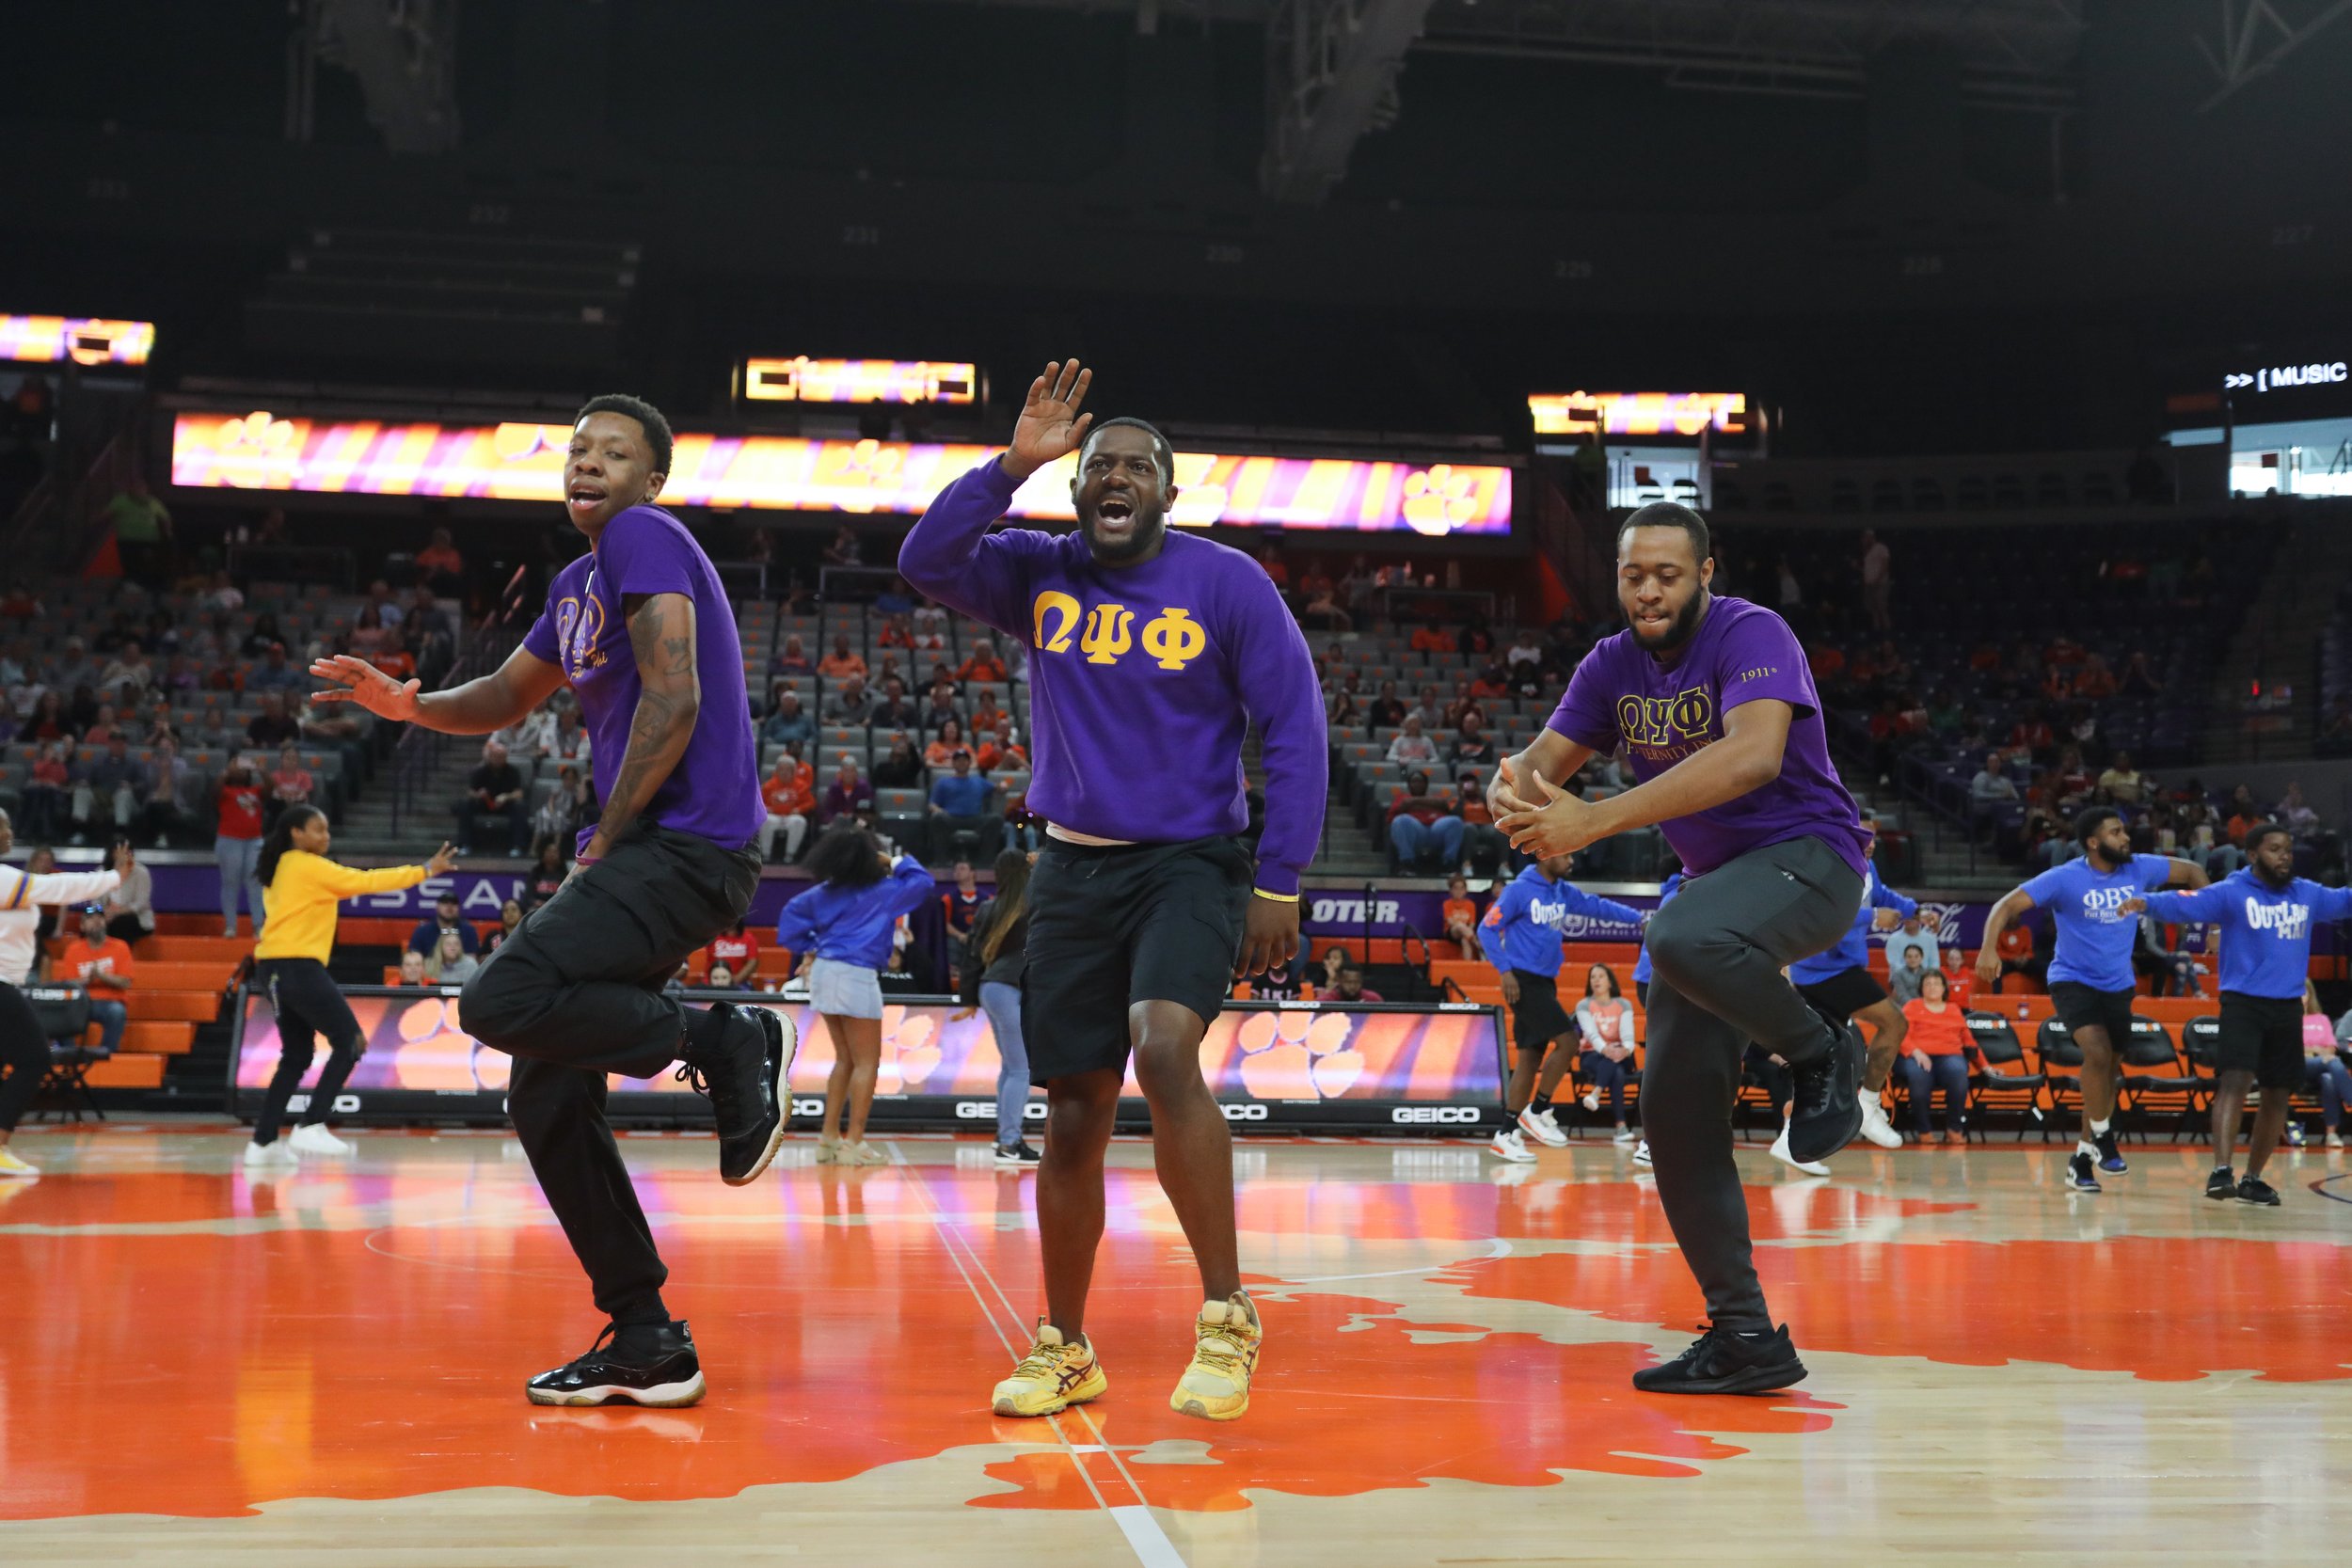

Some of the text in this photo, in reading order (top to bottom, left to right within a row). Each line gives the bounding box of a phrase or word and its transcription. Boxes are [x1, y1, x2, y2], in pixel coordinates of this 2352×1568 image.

[2270, 361, 2348, 388] MUSIC
[1033, 590, 1206, 670] ΩΨΦ
[1740, 667, 1770, 683] 1911
[1617, 686, 1712, 746] ΩΨΦ
[1311, 898, 1400, 924] OTER
[2130, 1022, 2161, 1033] EMSON
[955, 1102, 1048, 1119] GEO
[1391, 1106, 1481, 1124] GEICO
